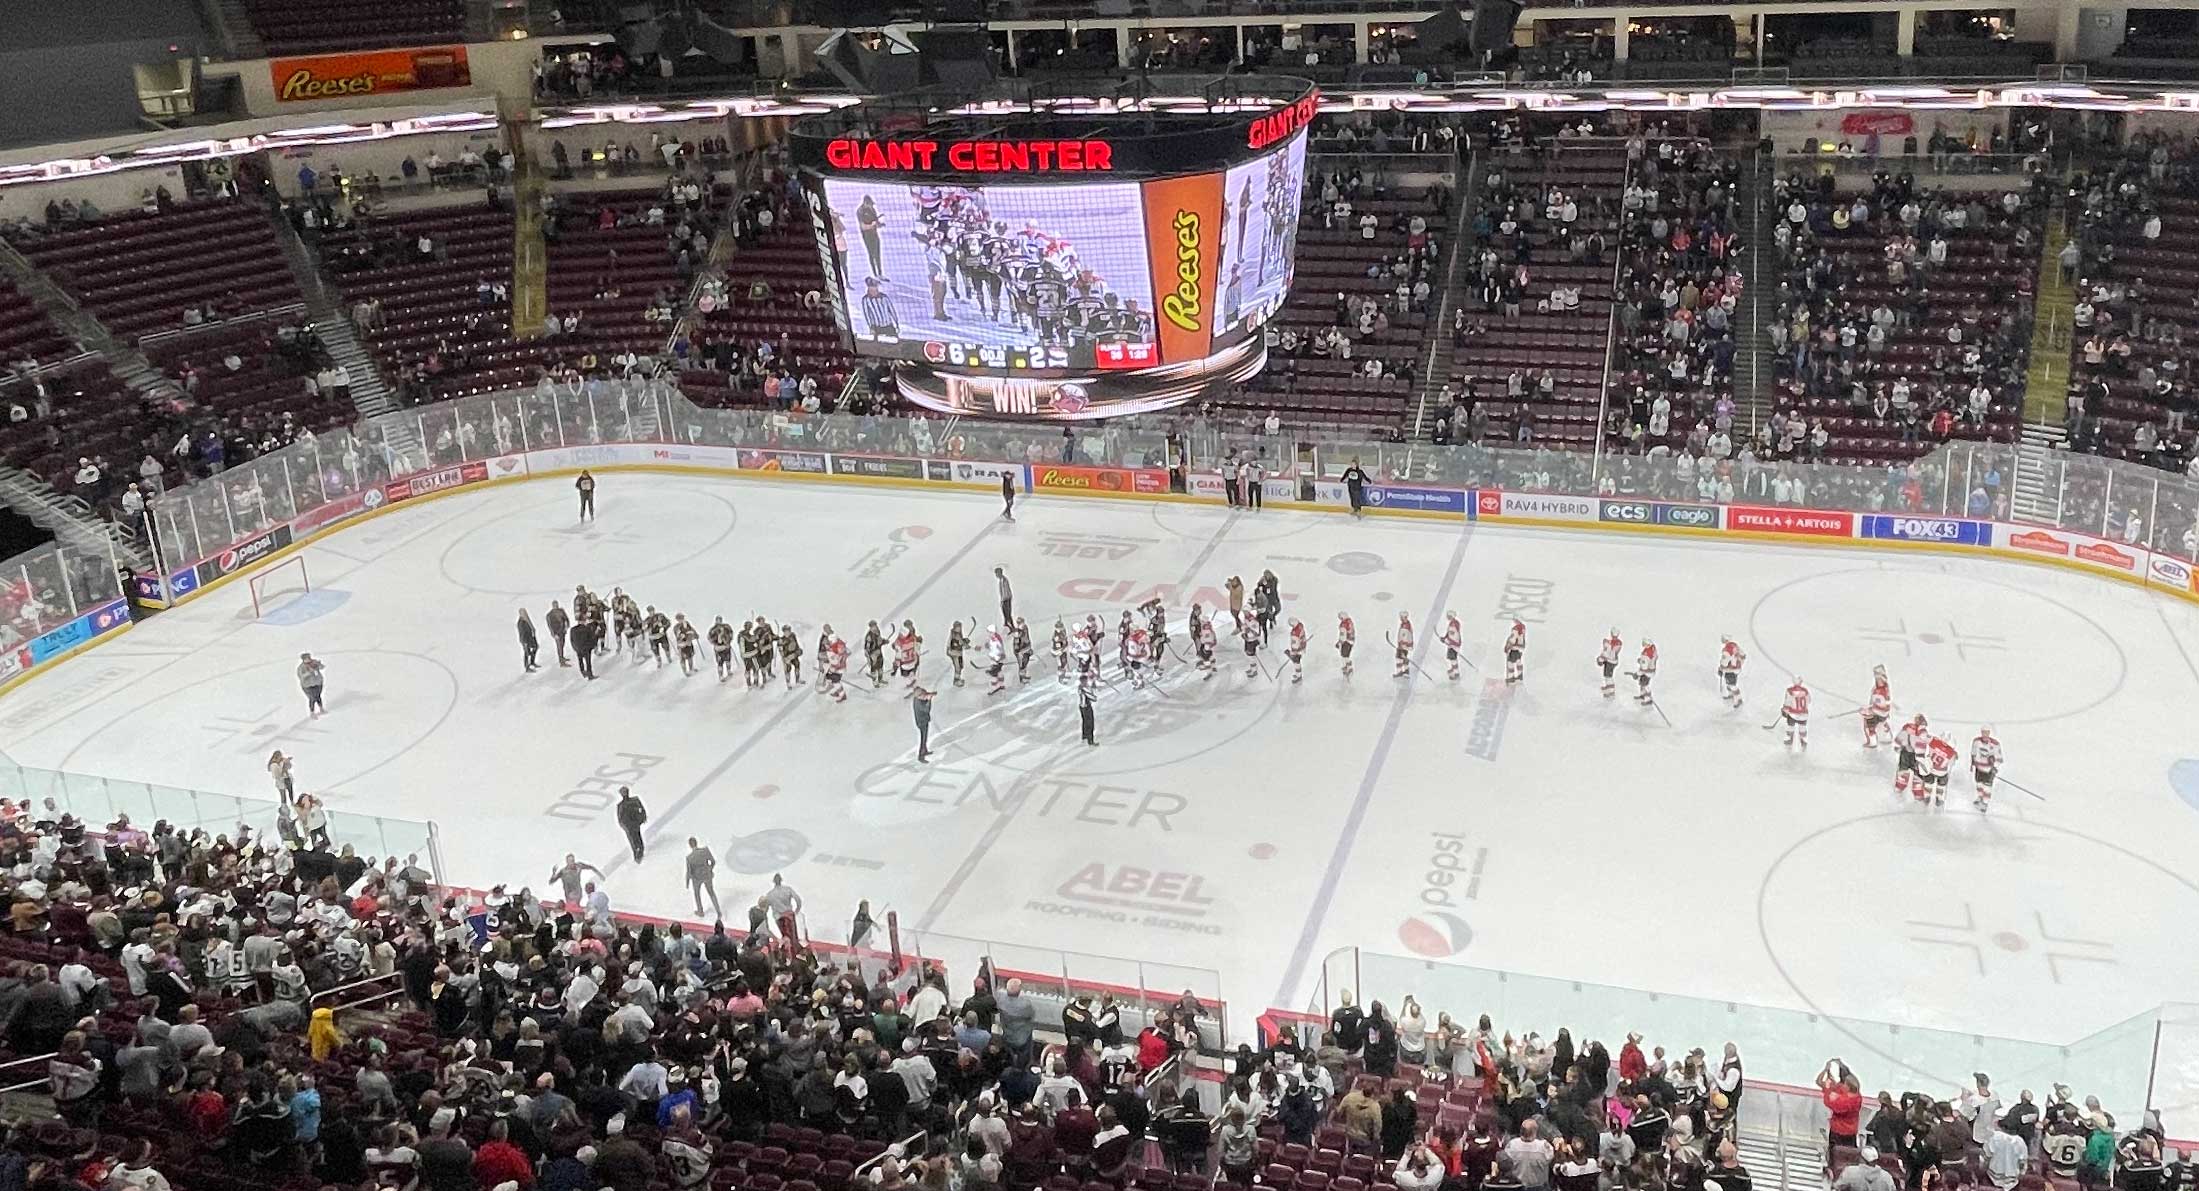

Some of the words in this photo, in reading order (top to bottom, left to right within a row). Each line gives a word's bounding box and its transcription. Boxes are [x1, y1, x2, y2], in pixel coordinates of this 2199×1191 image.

[283, 70, 375, 99] Reese's
[1248, 104, 1296, 149] GIANT
[827, 140, 938, 170] GIANT
[949, 141, 1112, 170] CENTER
[1163, 210, 1201, 331] Reese's
[950, 344, 965, 365] 6
[1029, 346, 1046, 369] 2
[992, 383, 1038, 414] WIN!
[974, 469, 1015, 478] RA
[1196, 479, 1226, 489] GIAN
[1506, 499, 1538, 512] RAV4
[1541, 503, 1590, 515] HYBRID
[1606, 504, 1645, 519] ecs
[1737, 514, 1782, 527] STELLA
[1795, 517, 1842, 530] ARTOIS
[1893, 518, 1959, 538] FOX43
[238, 534, 272, 559] pepsi
[854, 760, 1188, 832] CENTER
[1057, 863, 1214, 902] ABEL
[1420, 832, 1467, 908] pepsi
[1024, 900, 1126, 924] ROOFING
[1142, 915, 1222, 936] SIDING
[2061, 1145, 2076, 1161] 6
